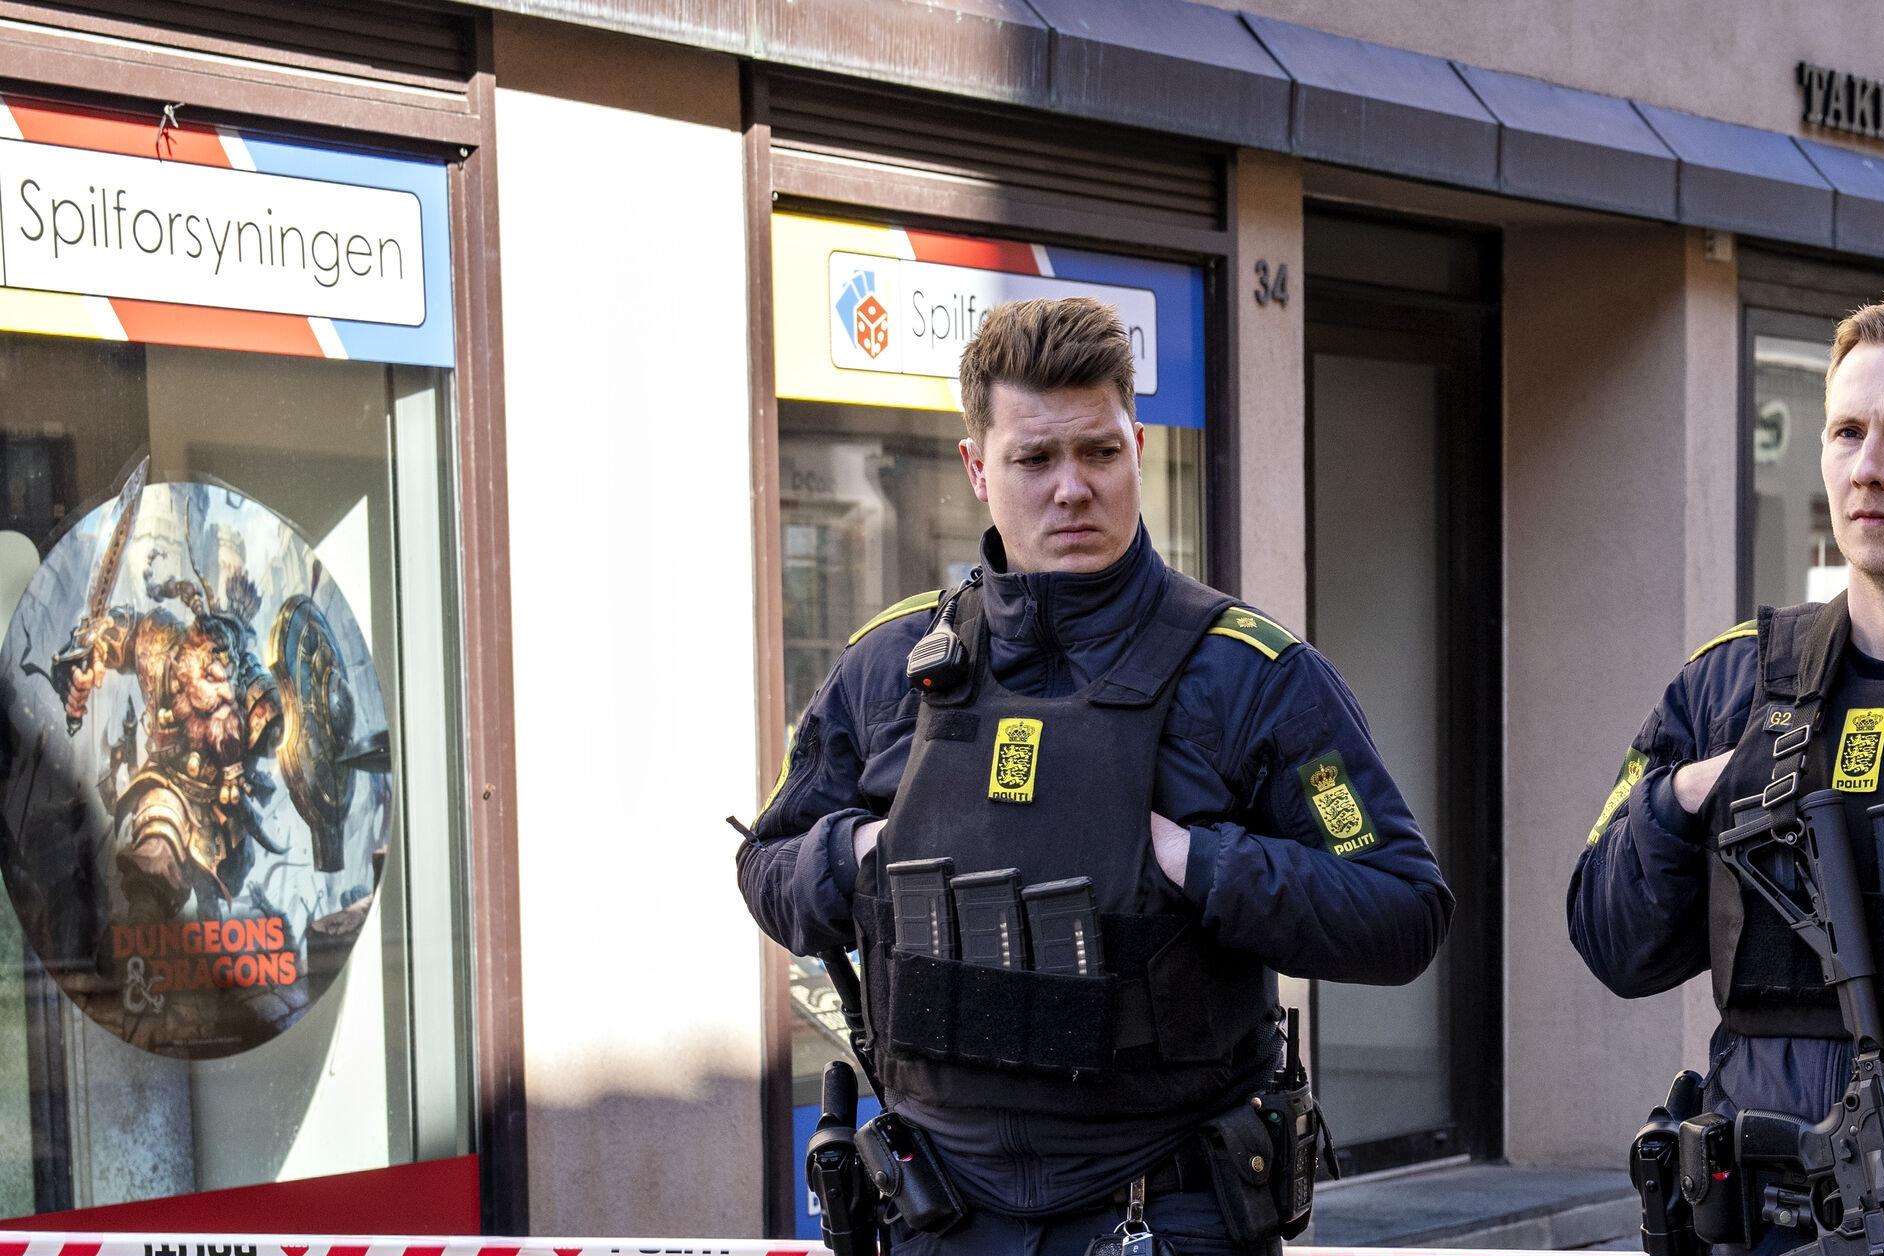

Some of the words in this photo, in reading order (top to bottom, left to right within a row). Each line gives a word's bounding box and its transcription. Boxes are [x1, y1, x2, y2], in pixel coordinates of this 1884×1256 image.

[19, 178, 404, 288] Spilforsyningen
[1253, 258, 1289, 308] 34
[1769, 711, 1793, 728] G2
[1836, 778, 1875, 789] POLITI
[1333, 832, 1376, 856] POLITI
[110, 917, 285, 958] DUNGEONS
[151, 952, 297, 994] DRAGONS
